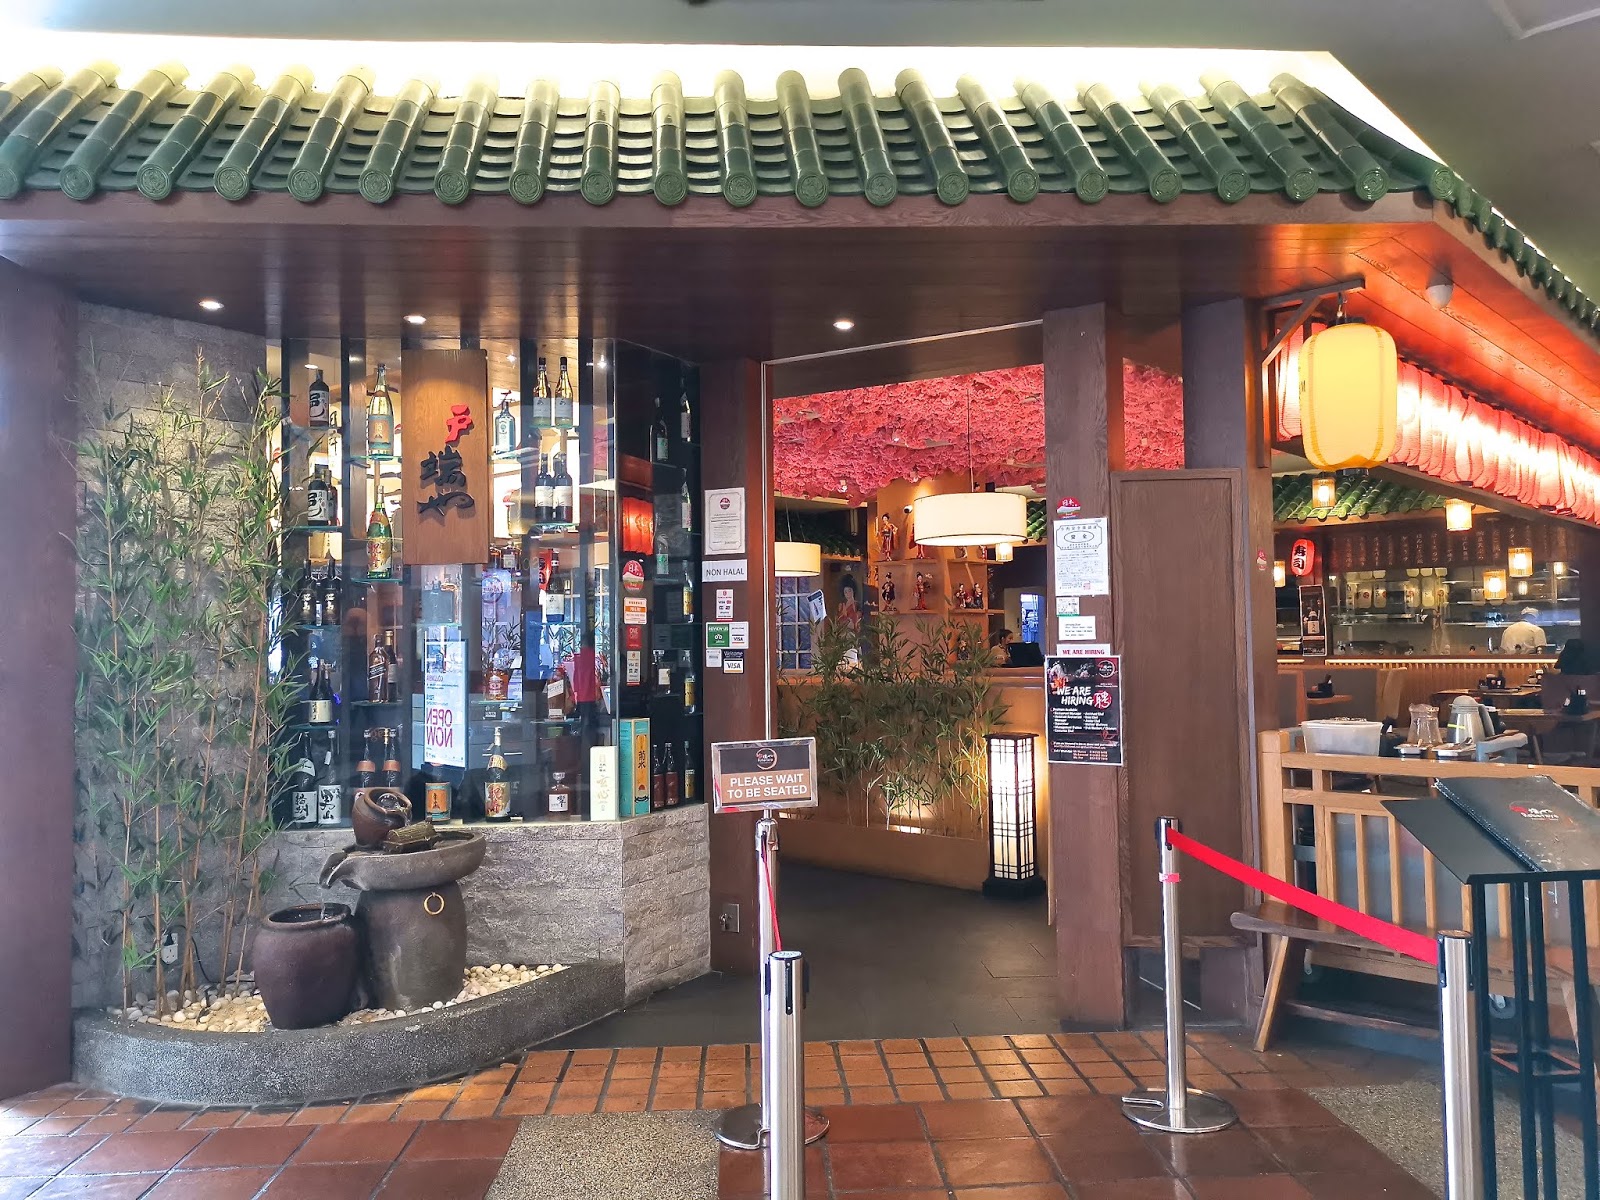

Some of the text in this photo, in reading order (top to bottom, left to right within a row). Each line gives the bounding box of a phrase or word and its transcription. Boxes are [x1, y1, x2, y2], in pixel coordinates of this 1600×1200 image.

[706, 567, 745, 578] NON HALAL
[1057, 686, 1092, 696] WE ARE
[1061, 696, 1094, 706] HIRING
[730, 773, 804, 788] PLEASE WAIT
[727, 785, 807, 799] TO BE SEATED
